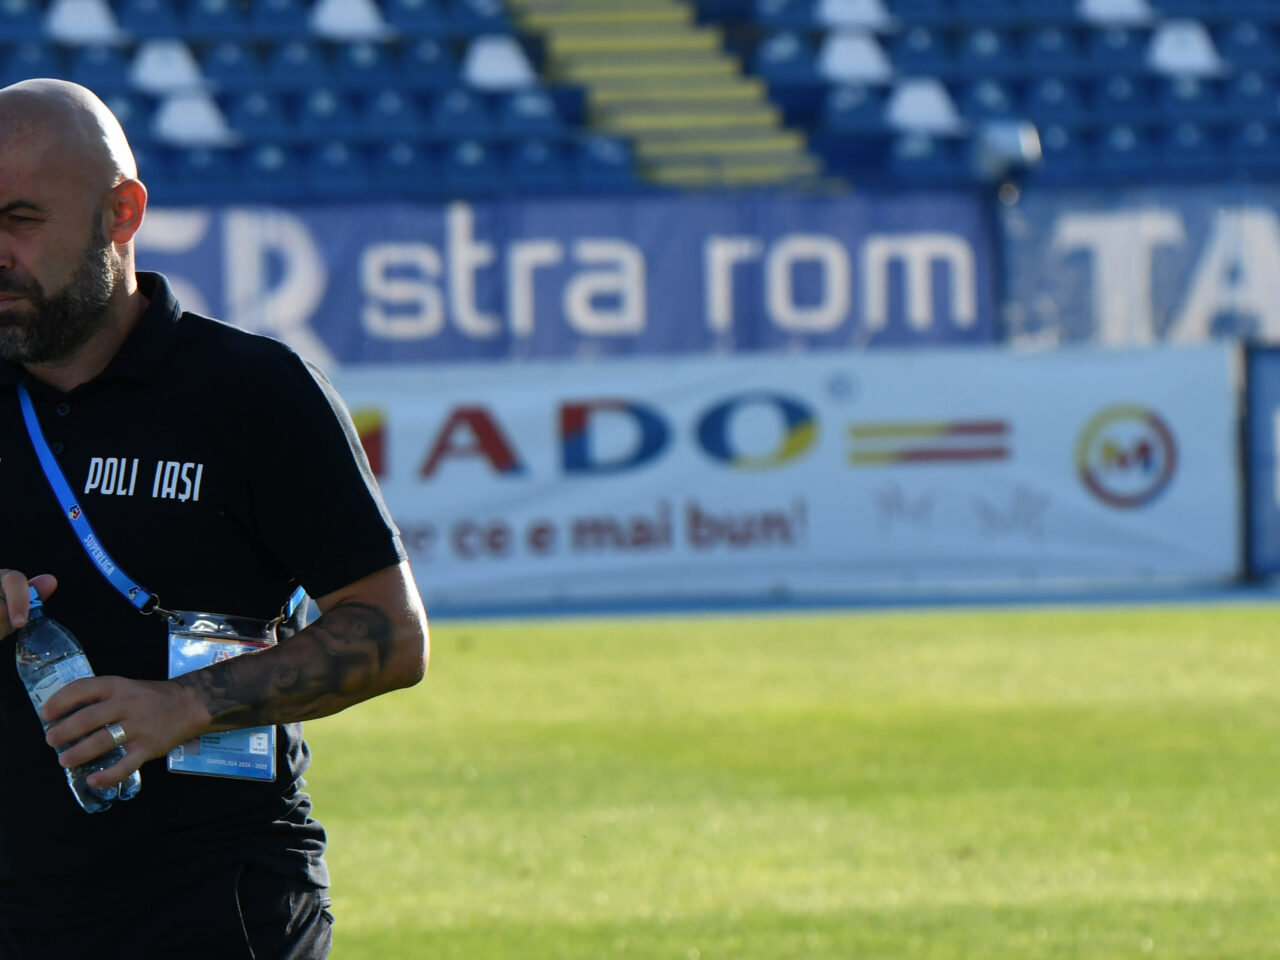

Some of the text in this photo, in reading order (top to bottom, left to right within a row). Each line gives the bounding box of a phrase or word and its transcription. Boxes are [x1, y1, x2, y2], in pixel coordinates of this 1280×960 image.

[360, 203, 978, 340] stra rom
[84, 457, 139, 496] POLI
[84, 534, 115, 576] SUPERLIGA
